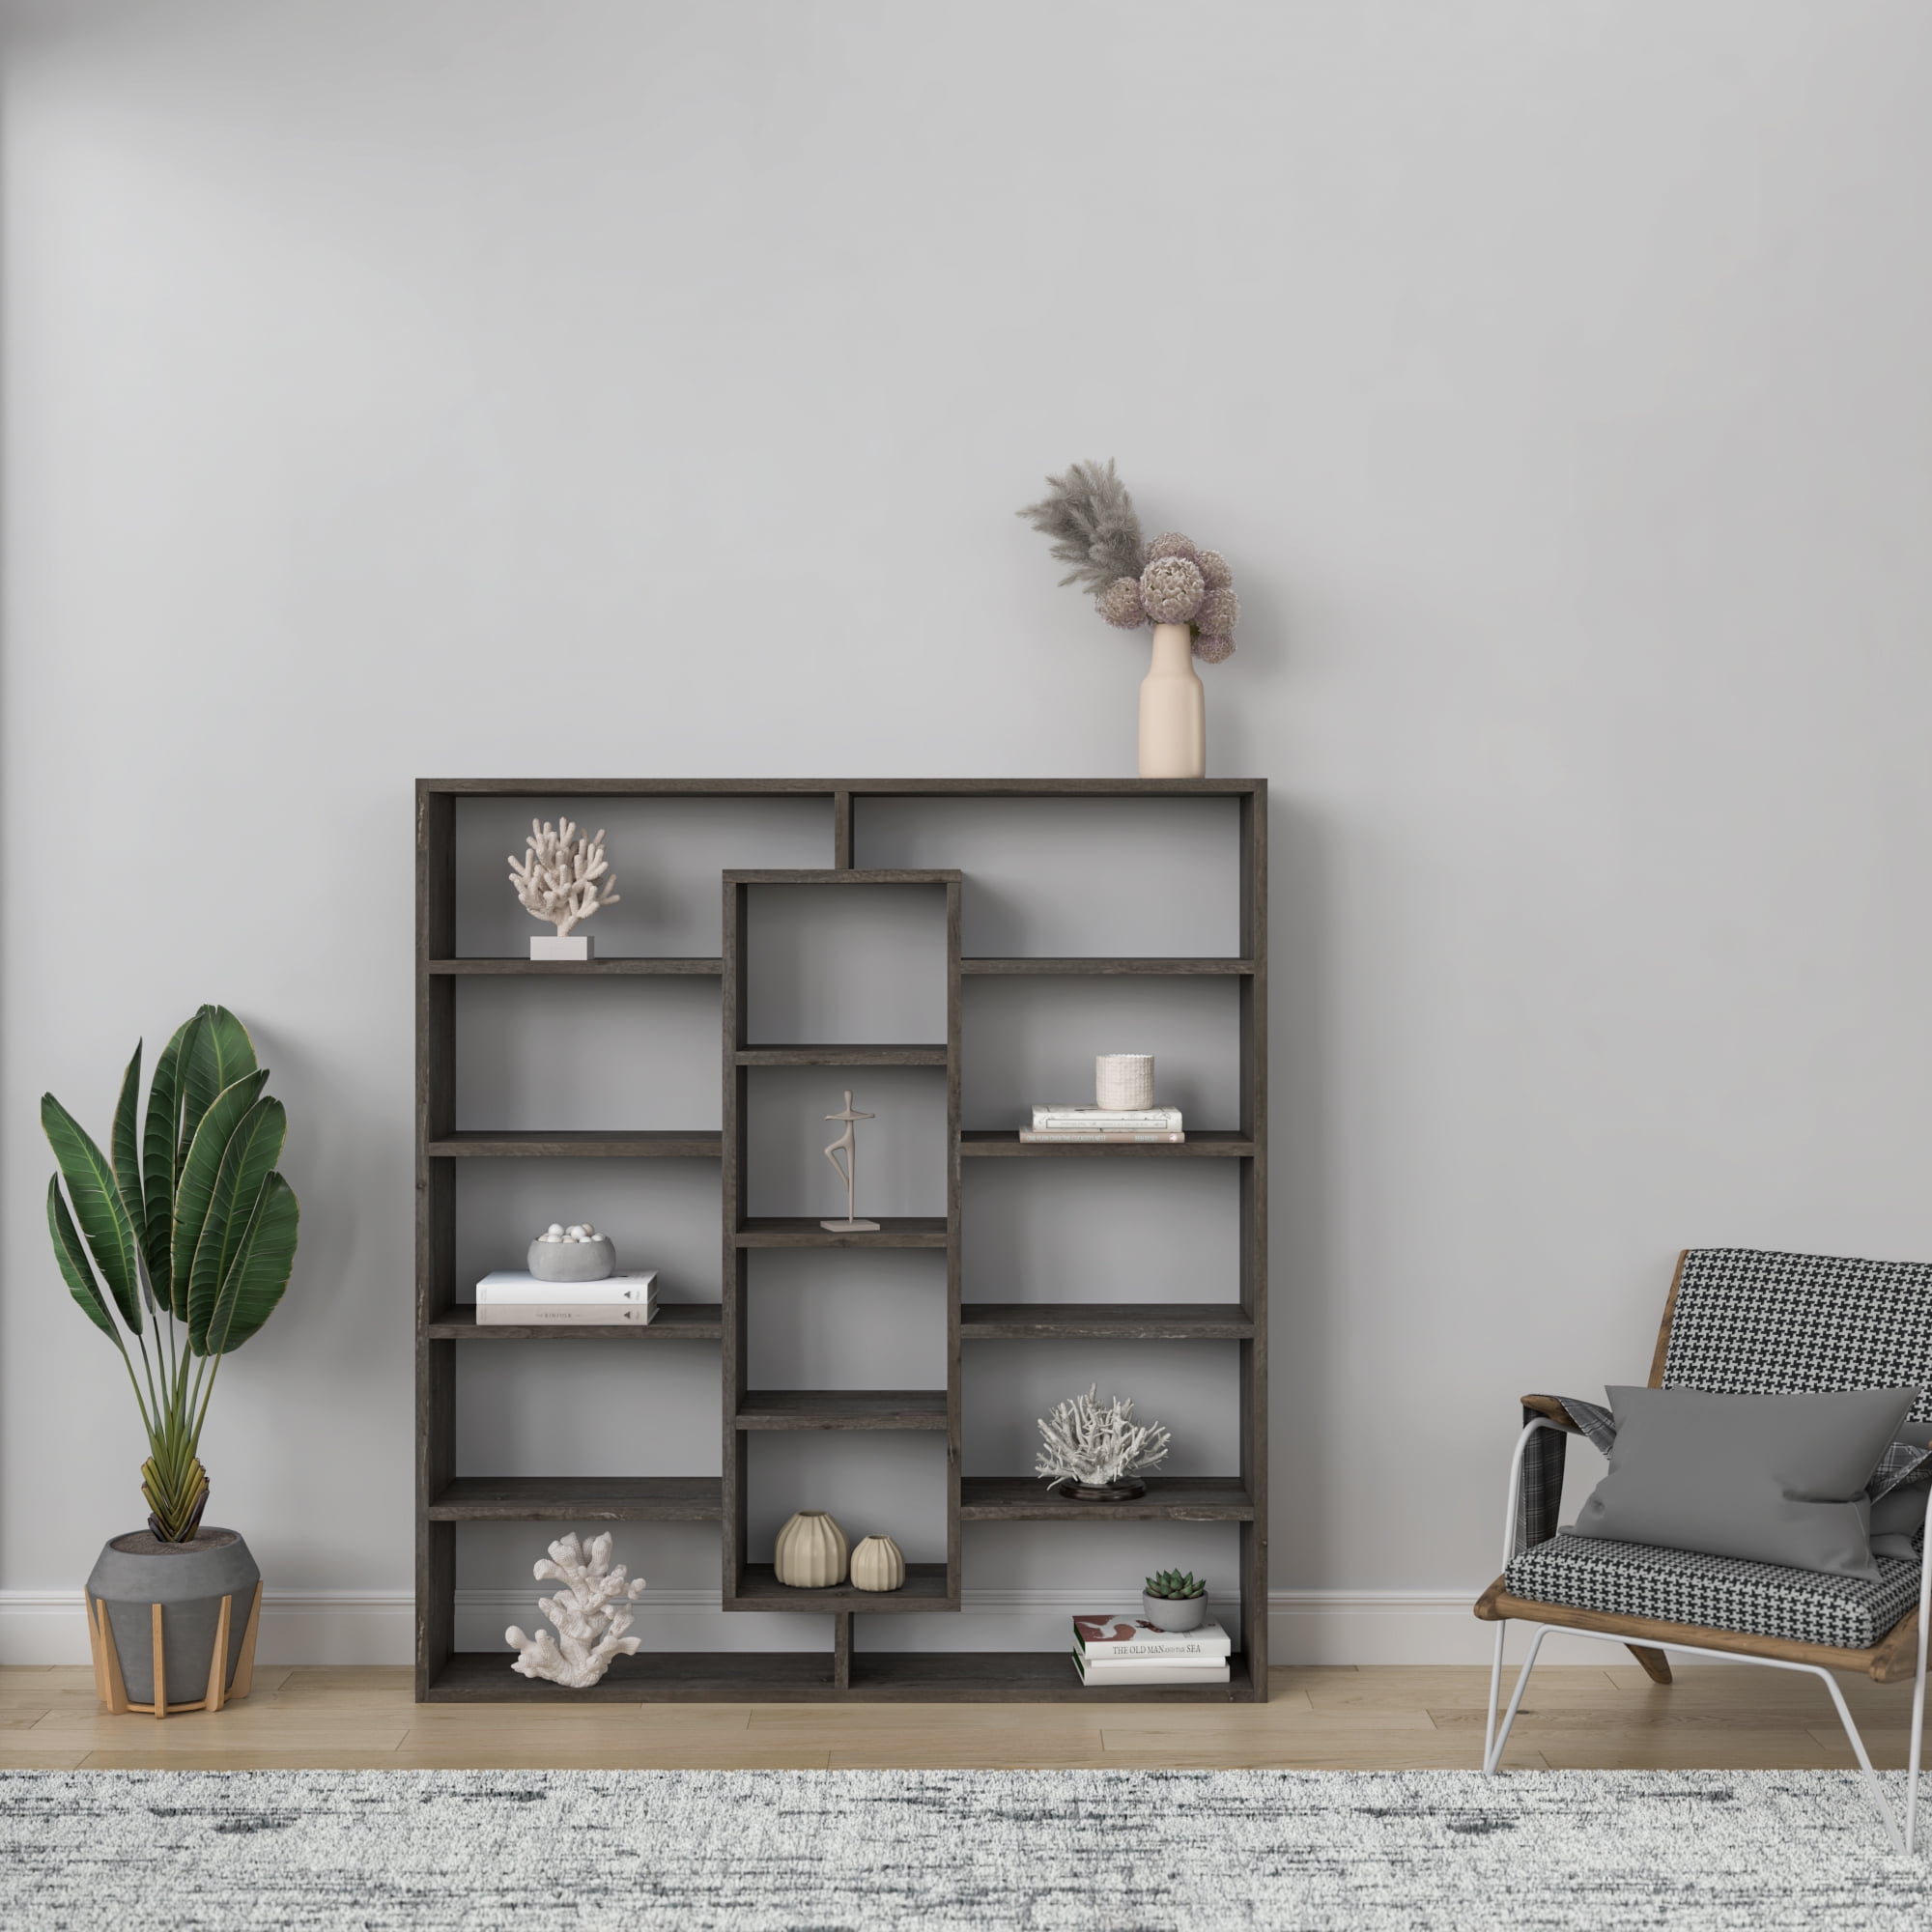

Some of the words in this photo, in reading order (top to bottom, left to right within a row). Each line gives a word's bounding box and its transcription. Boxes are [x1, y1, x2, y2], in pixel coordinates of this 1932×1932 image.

[1112, 1646, 1128, 1655] THE
[1129, 1645, 1147, 1654] OLD
[1148, 1645, 1164, 1654] MAN
[1186, 1644, 1202, 1653] SEA
